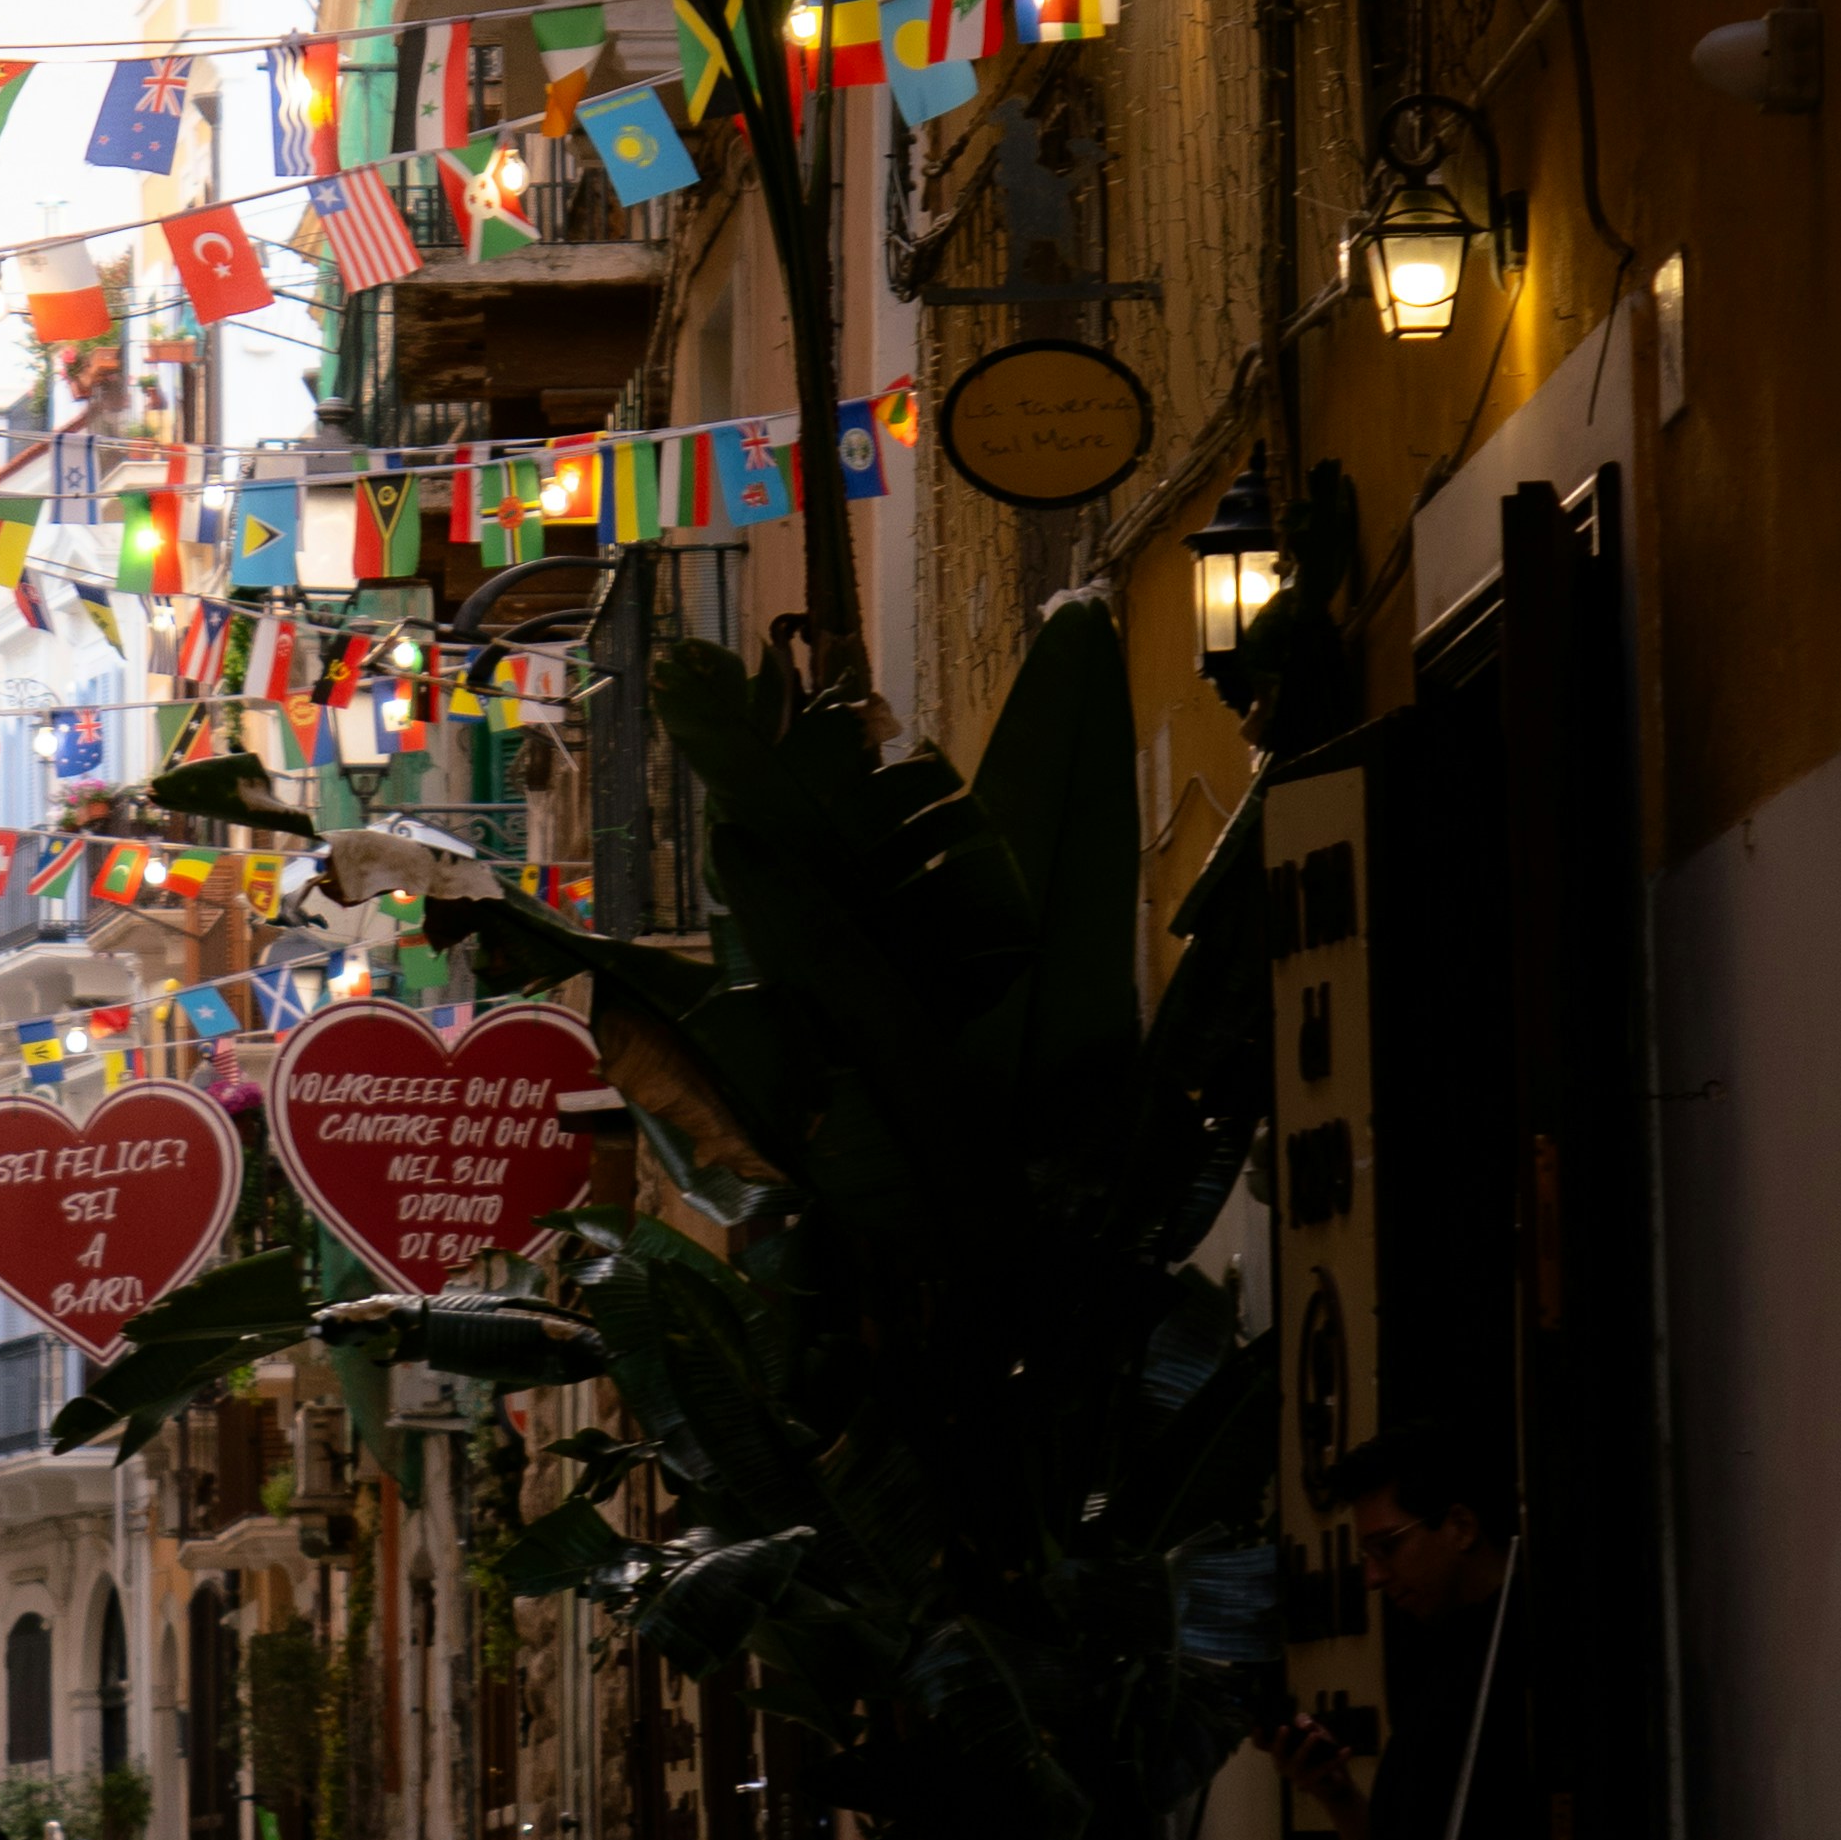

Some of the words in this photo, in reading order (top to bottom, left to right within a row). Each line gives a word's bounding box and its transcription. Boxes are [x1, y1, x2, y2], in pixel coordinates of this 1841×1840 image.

[464, 1077, 508, 1109] OH
[509, 1078, 553, 1110] OH
[318, 1113, 447, 1146] CANTARE
[449, 1115, 494, 1148] OH
[494, 1117, 539, 1149] OH
[52, 1139, 189, 1181] FELICE?
[387, 1153, 447, 1184] NEL
[451, 1156, 510, 1186] BLU
[60, 1187, 120, 1224] SEI
[397, 1193, 504, 1225] DIPINTO
[78, 1232, 108, 1268] A
[398, 1232, 436, 1260] DI
[50, 1277, 145, 1318] BARI!
